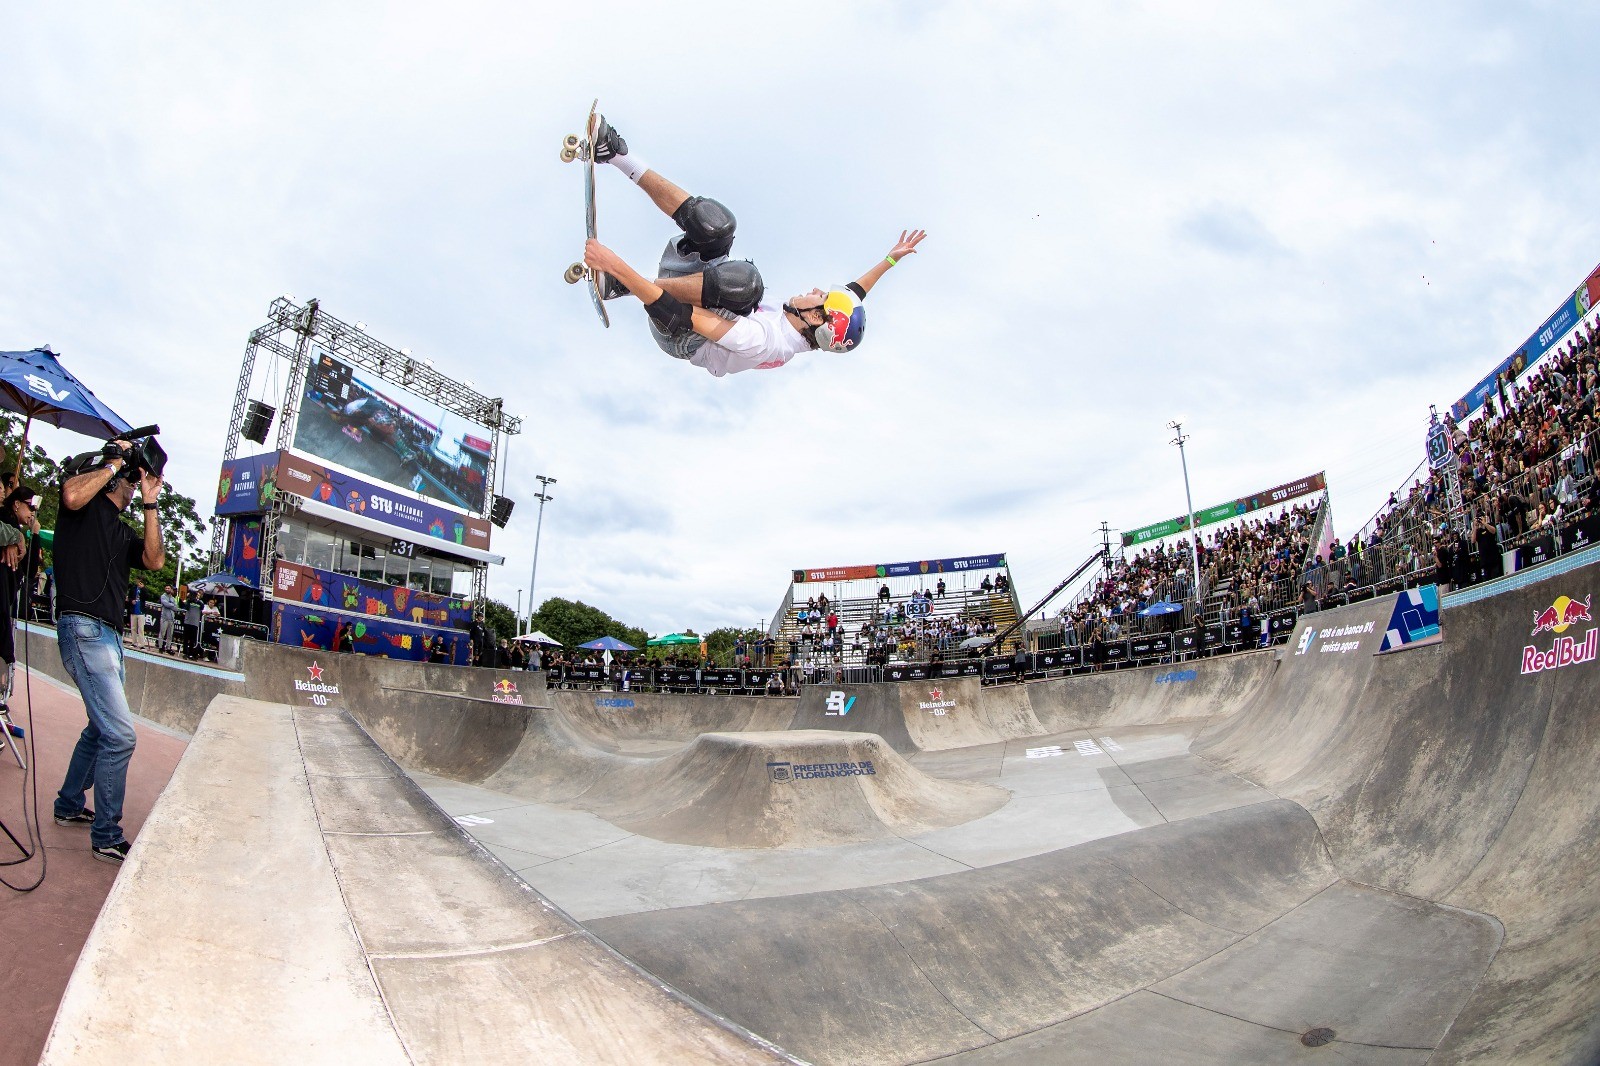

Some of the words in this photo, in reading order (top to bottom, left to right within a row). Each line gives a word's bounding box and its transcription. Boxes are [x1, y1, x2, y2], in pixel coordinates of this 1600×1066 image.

[1539, 327, 1554, 347] STU
[242, 471, 250, 480] STU
[1288, 482, 1309, 493] NATIONAL
[1271, 489, 1288, 500] STU
[370, 494, 392, 514] STU
[394, 502, 424, 518] NATIONAL
[1138, 530, 1152, 540] STU
[954, 560, 968, 569] STU
[810, 572, 826, 580] STU
[1344, 624, 1364, 636] banco
[1320, 640, 1340, 653] invista
[1340, 640, 1360, 654] agora
[1521, 638, 1560, 674] Red
[1558, 628, 1598, 667] Bull
[294, 680, 340, 694] Heineken
[919, 698, 956, 710] Heineken
[793, 762, 858, 772] PREFEITURA
[858, 760, 874, 768] DE
